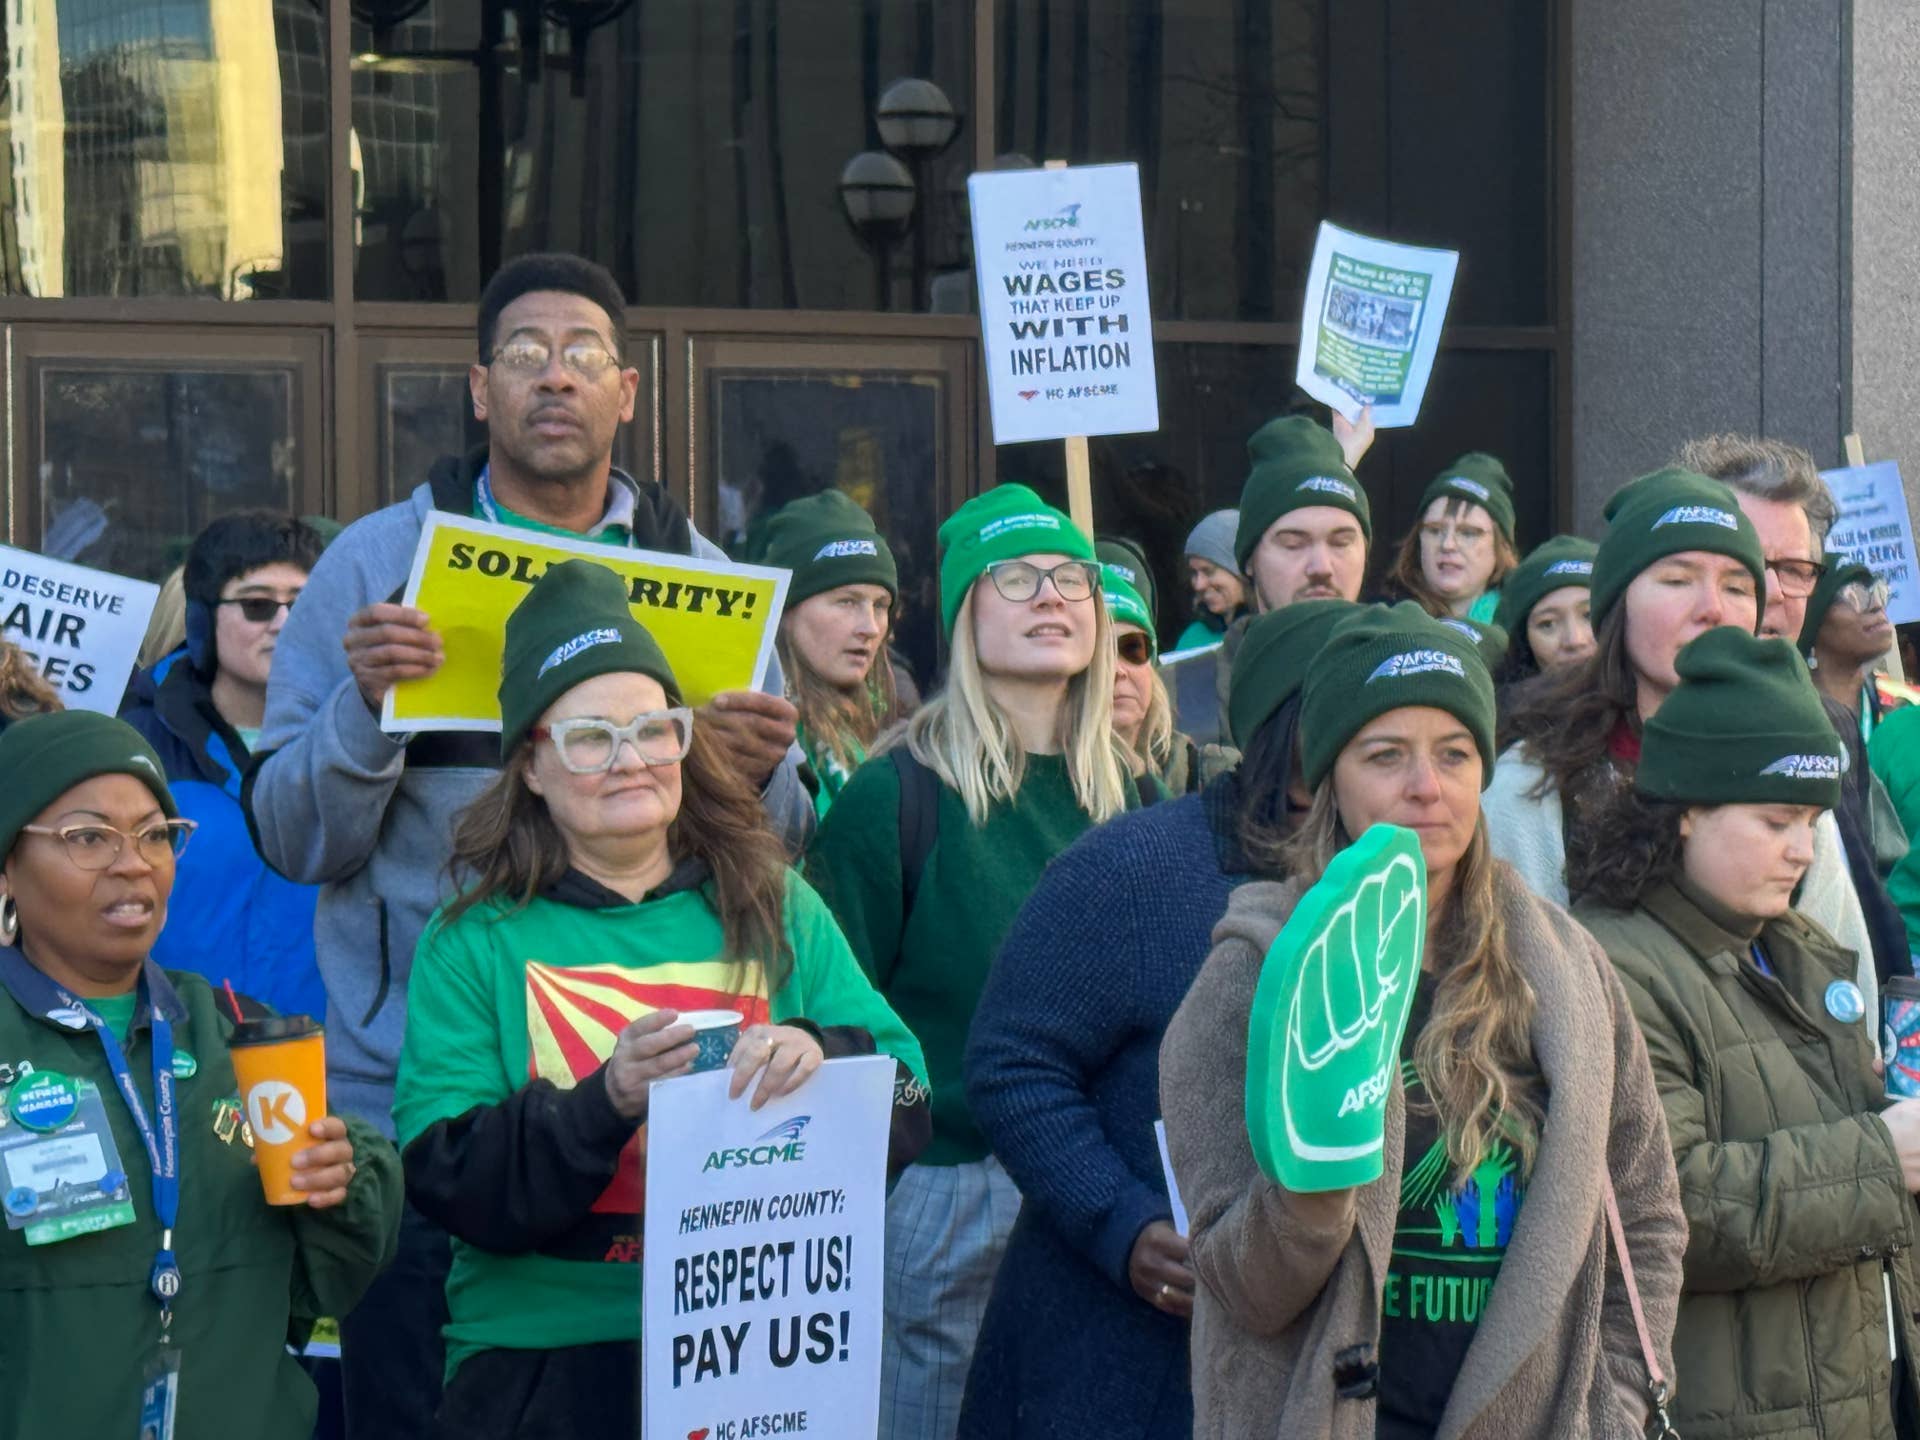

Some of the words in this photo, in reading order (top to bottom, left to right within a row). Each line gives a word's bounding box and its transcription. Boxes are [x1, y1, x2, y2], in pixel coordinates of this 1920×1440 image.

[1003, 268, 1126, 296] WAGES
[1010, 299, 1048, 314] THAT
[1055, 296, 1095, 312] KEEP
[1100, 295, 1120, 309] UP
[1008, 314, 1129, 340] WITH
[1010, 342, 1131, 376] INFLATION
[3, 568, 125, 616] DESERVE
[702, 1141, 806, 1173] AFSCME
[679, 1198, 764, 1235] HENNEPIN
[767, 1188, 846, 1220] COUNTY:
[674, 1241, 795, 1316] RESPECT
[805, 1235, 853, 1295] US!
[672, 1321, 751, 1389] PAY
[769, 1310, 850, 1368] US!
[716, 1423, 737, 1440] HC
[740, 1410, 808, 1439] AFSCME
